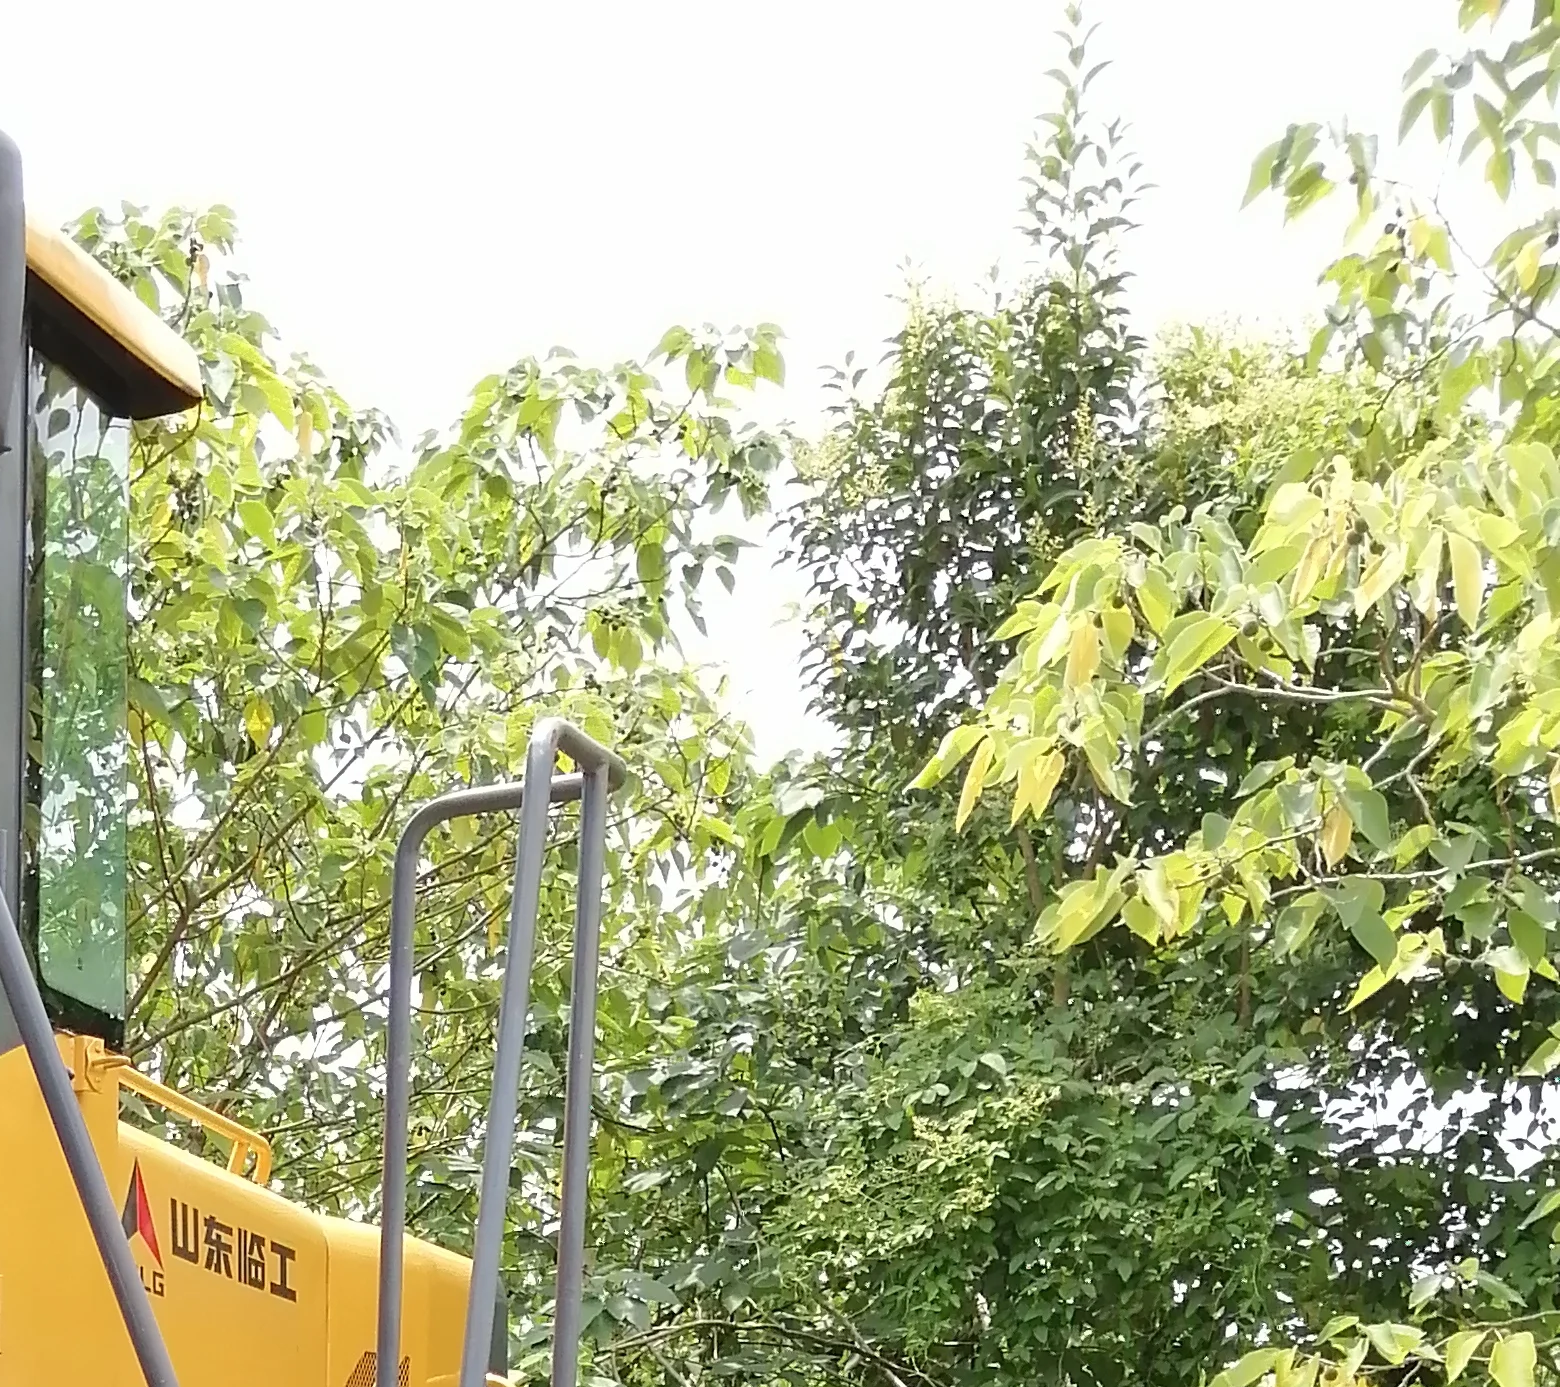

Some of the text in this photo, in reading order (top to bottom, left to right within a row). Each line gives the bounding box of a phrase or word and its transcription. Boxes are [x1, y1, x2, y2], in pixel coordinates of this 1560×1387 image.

[140, 1266, 165, 1297] LG
[170, 1197, 298, 1303] 山东临工
